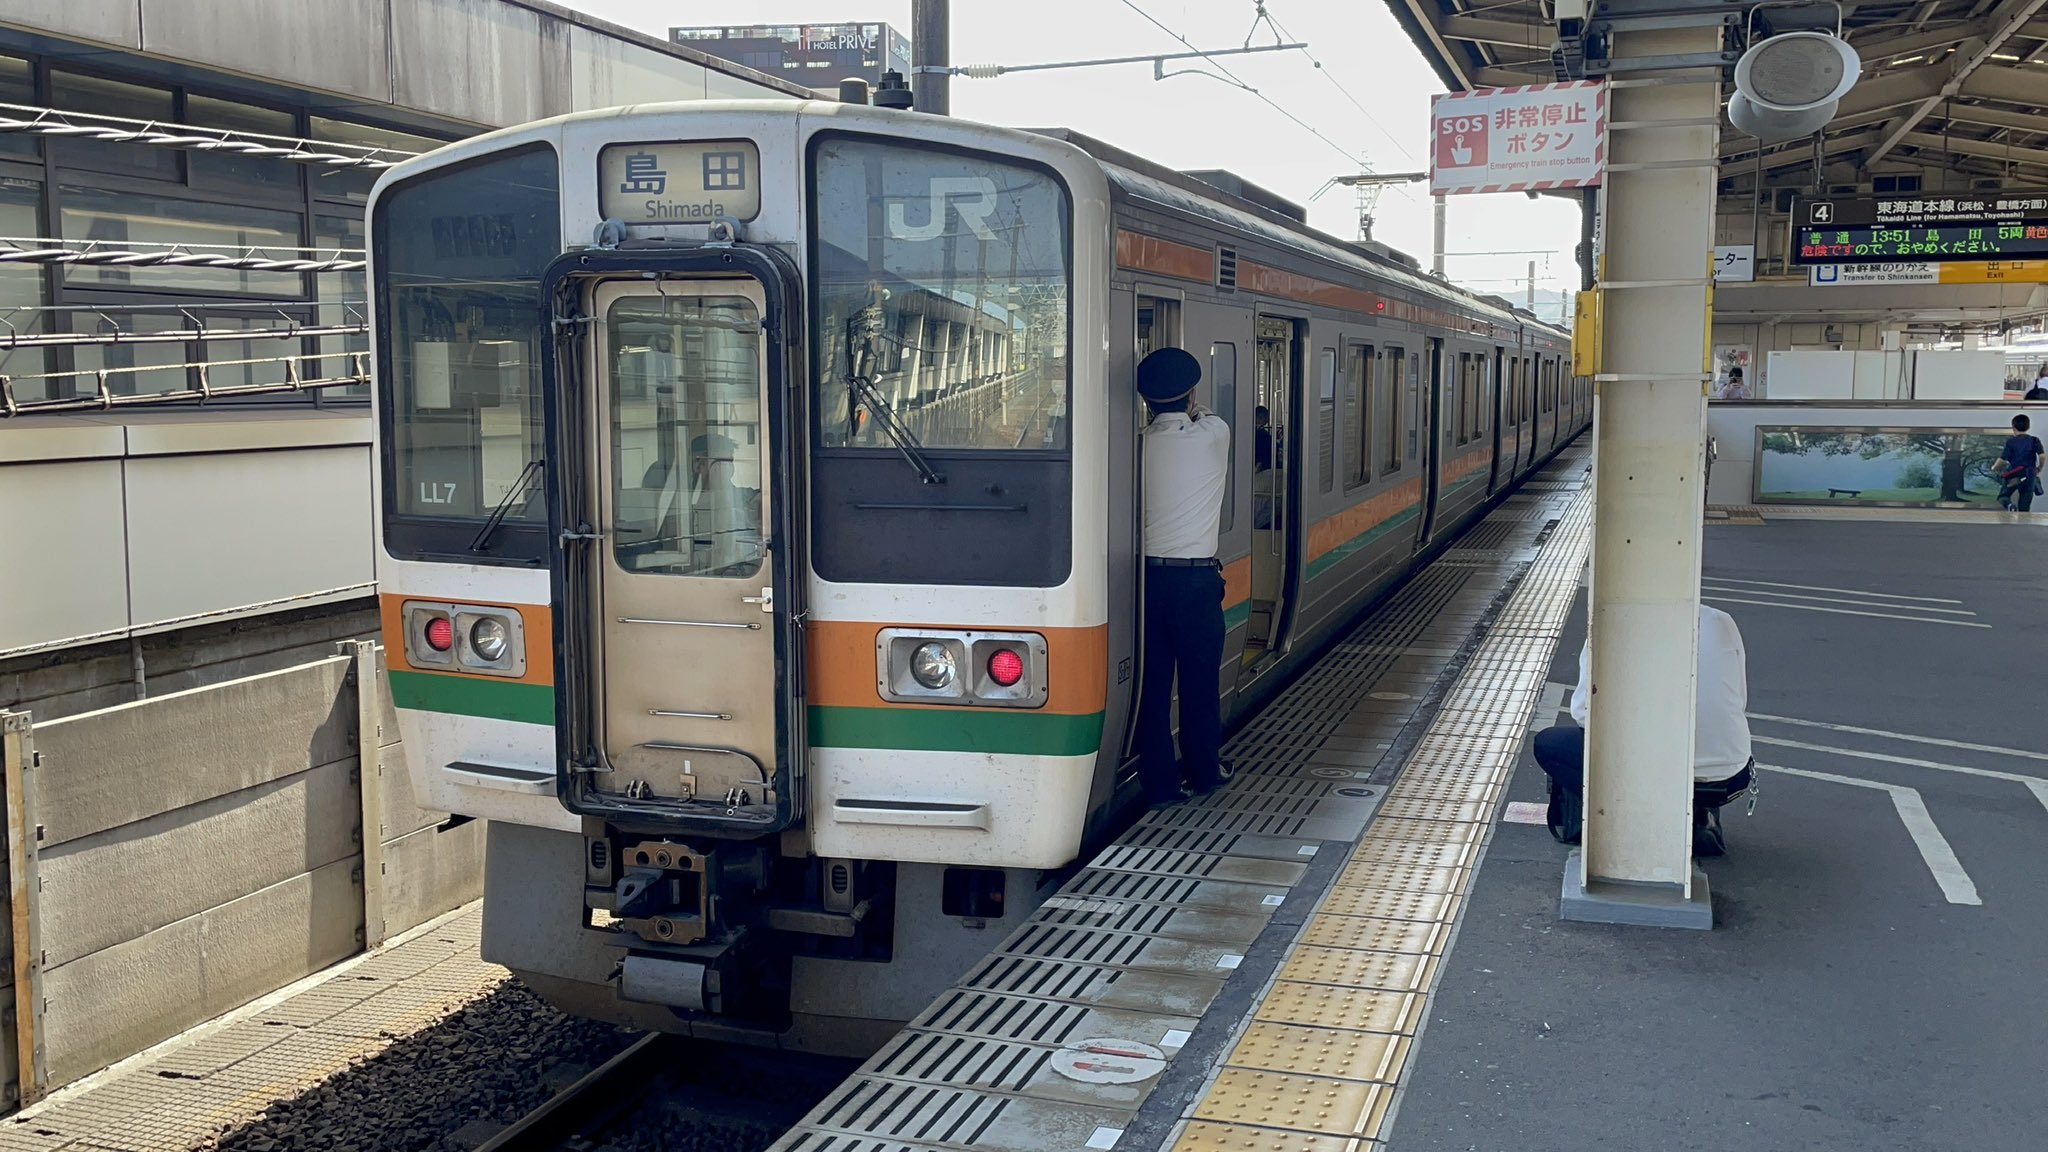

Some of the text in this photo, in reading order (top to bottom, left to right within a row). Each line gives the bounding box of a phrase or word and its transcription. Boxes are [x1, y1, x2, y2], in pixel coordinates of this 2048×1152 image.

[813, 41, 838, 50] HOTEL
[1495, 102, 1587, 130] 非常停止
[1442, 117, 1484, 134] SOS
[1507, 132, 1574, 154] ボタン
[1490, 156, 1591, 171] Emergency train stop button
[645, 199, 724, 219] Shimada
[888, 176, 999, 241] JR
[1815, 205, 1829, 221] 4
[1923, 213, 1937, 222] (for
[1871, 230, 1911, 243] 13:51
[1801, 241, 2001, 256] 危険ですので、おやめください。
[1843, 263, 1929, 273] 新幹線のりかえ
[1887, 273, 1933, 281] Shinkansen
[421, 482, 456, 503] LL7
